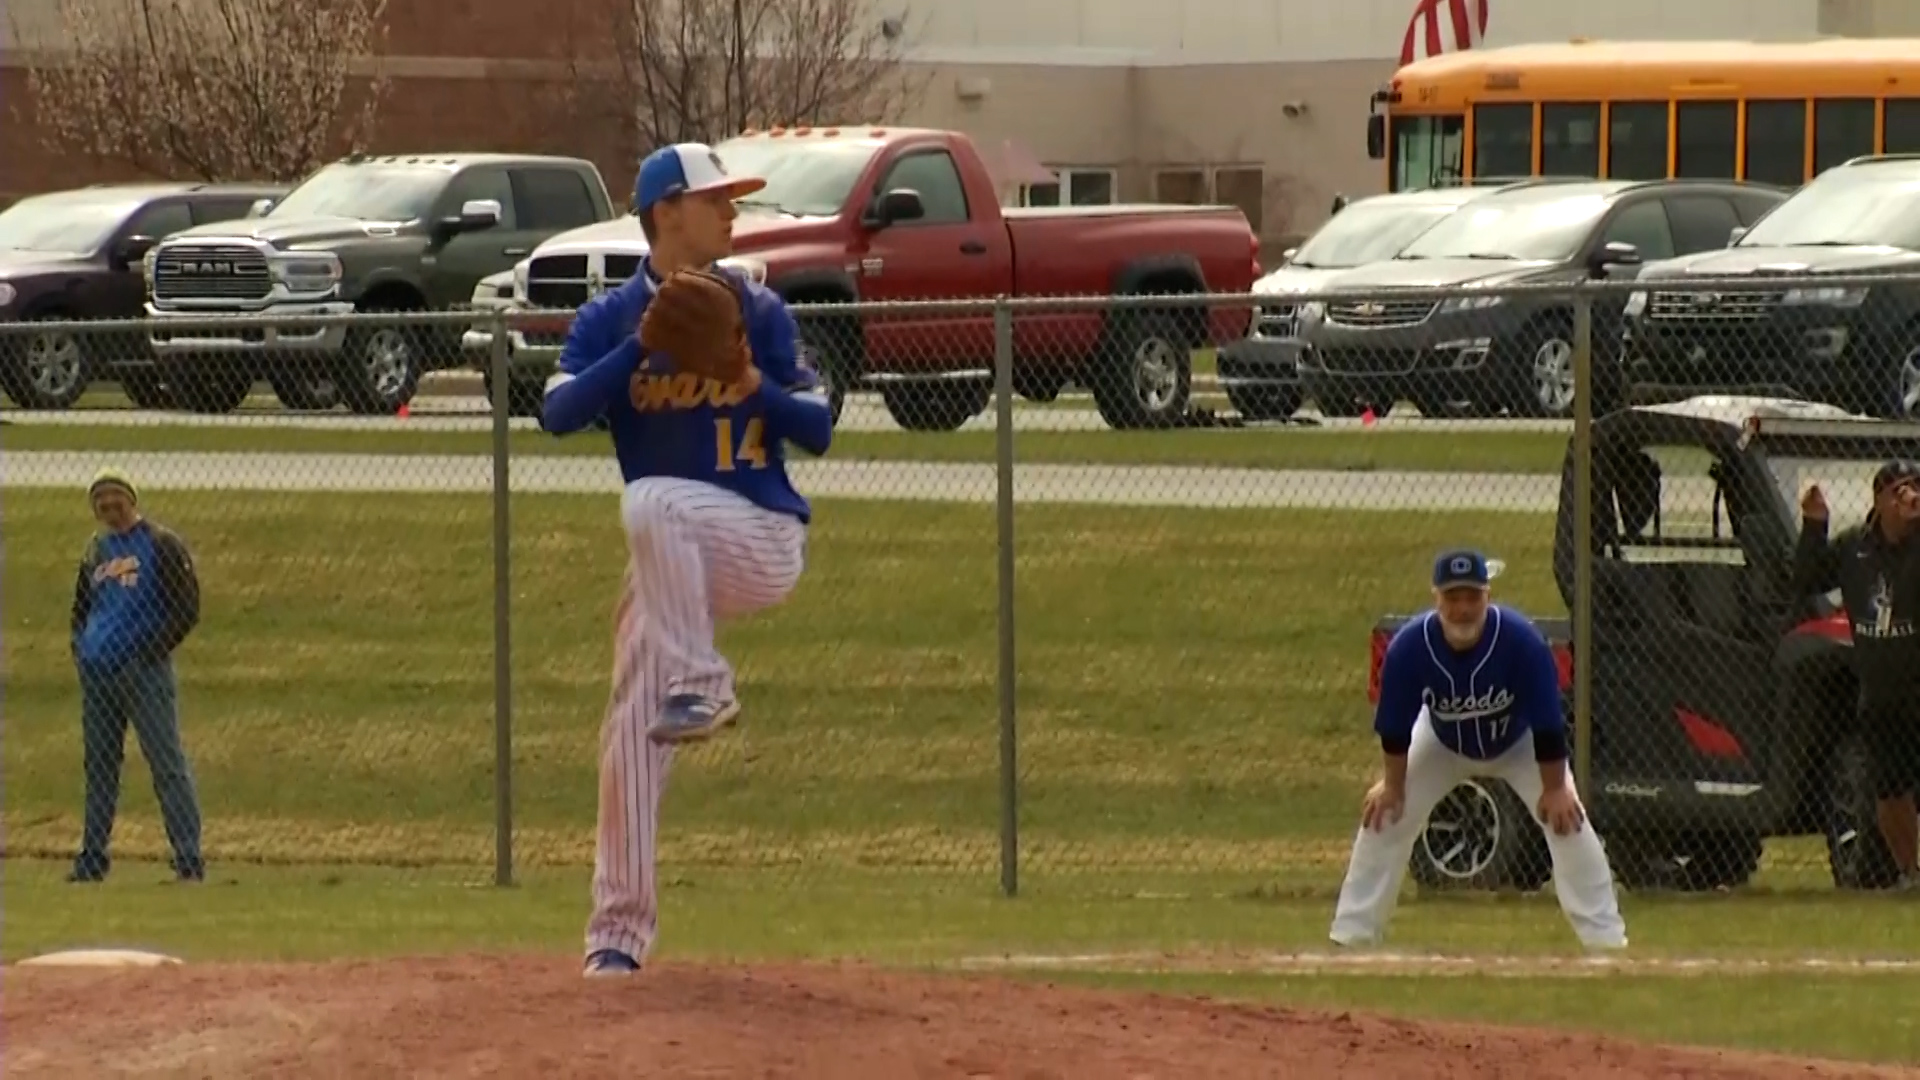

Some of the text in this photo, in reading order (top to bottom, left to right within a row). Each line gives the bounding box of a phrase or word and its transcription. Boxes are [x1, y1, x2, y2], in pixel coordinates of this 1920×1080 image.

[182, 262, 231, 274] RAM
[713, 416, 767, 471] 14
[1422, 685, 1515, 722] Oscoda
[1489, 715, 1511, 741] 17
